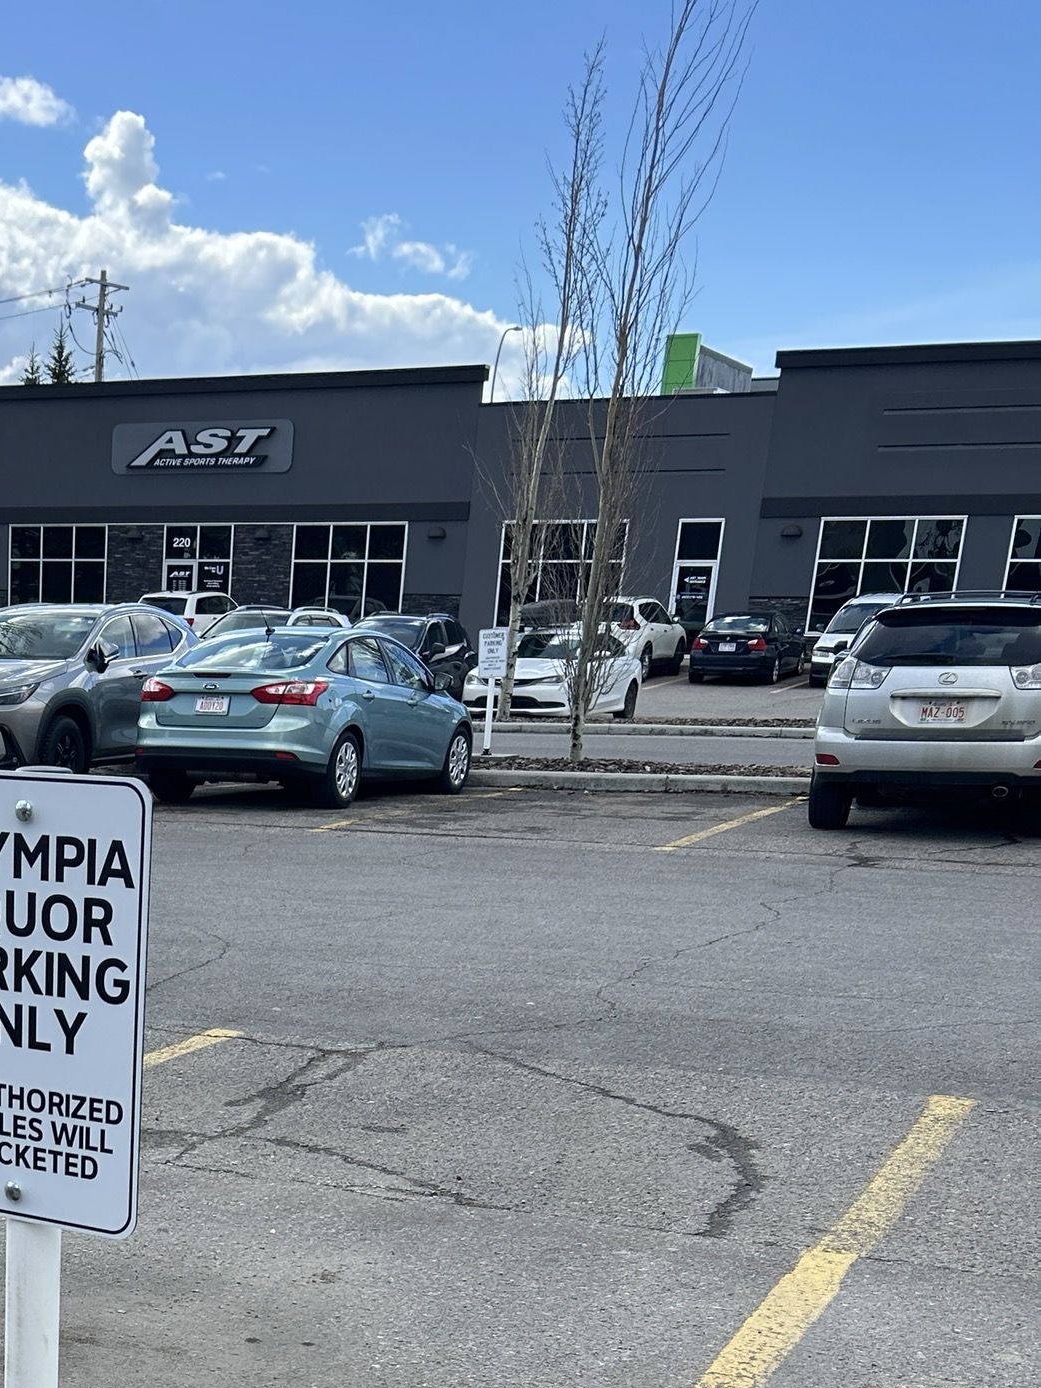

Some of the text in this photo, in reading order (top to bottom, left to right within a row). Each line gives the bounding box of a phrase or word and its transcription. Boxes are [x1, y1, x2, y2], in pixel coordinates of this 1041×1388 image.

[130, 428, 271, 466] AST
[154, 456, 256, 466] ACTIVE SPORTS THERAPY
[173, 537, 191, 548] 220
[920, 707, 965, 719] MAZ-005
[50, 1121, 114, 1155] WILL
